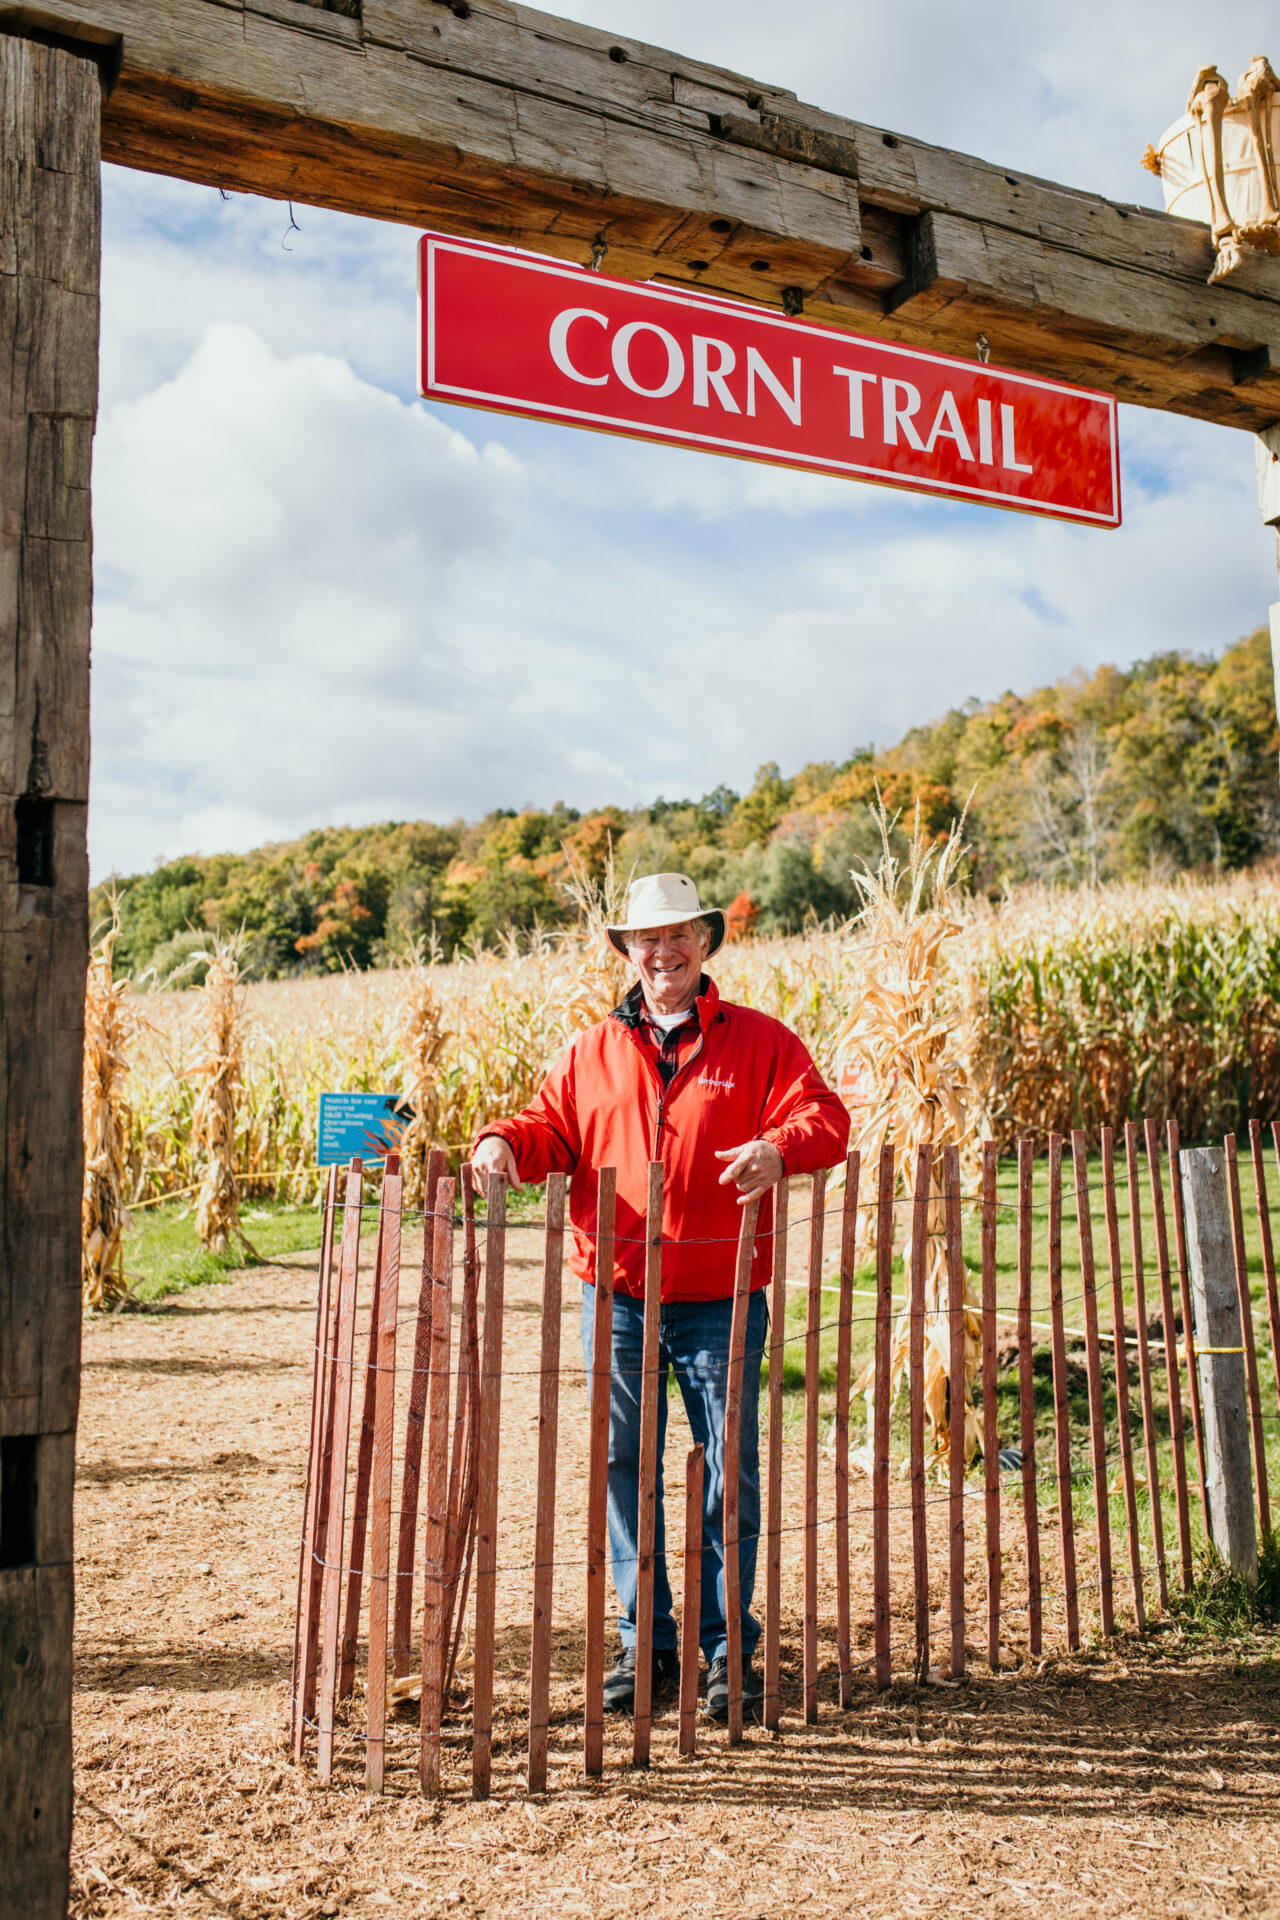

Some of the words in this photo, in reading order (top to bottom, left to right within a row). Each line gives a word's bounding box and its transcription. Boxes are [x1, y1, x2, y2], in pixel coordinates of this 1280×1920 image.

[548, 307, 802, 426] CORN
[832, 365, 1033, 474] TRAIL
[345, 1112, 373, 1120] Testing
